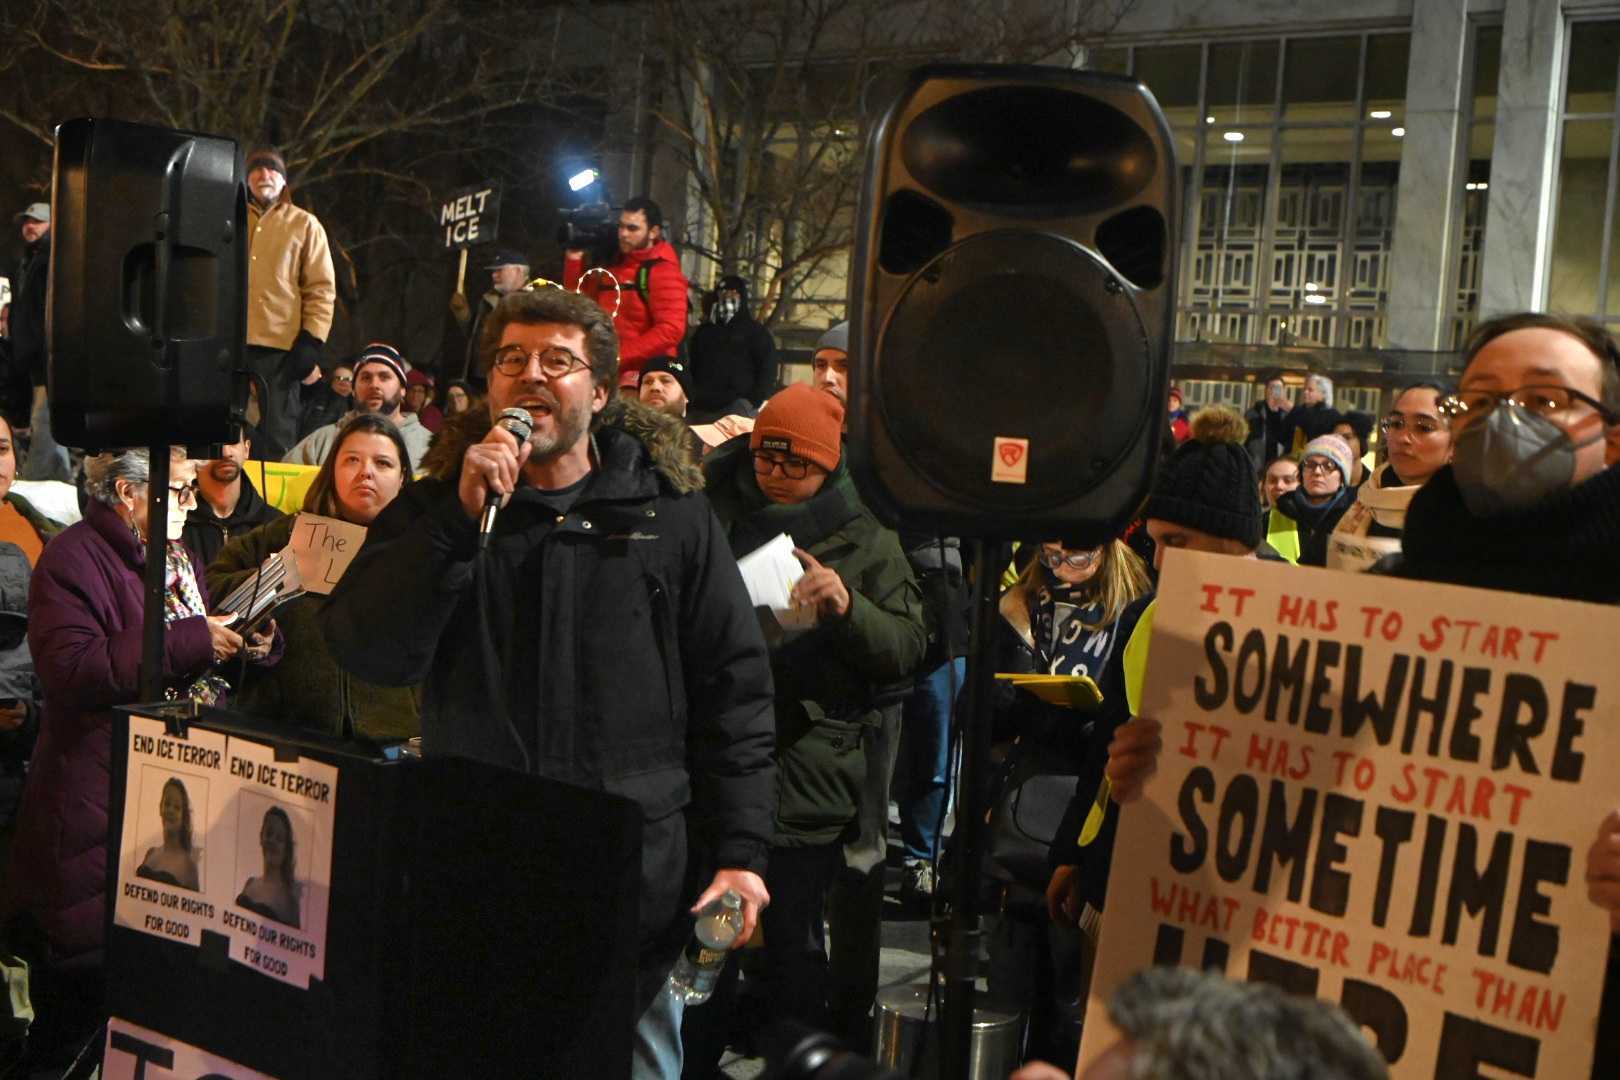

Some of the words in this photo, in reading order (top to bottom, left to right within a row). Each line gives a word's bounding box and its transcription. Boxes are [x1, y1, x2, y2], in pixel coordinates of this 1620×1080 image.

[441, 189, 492, 226] MELT
[446, 217, 480, 247] ICE
[304, 522, 347, 552] The
[1200, 584, 1256, 617] IT
[1277, 595, 1338, 632] HAS
[1361, 606, 1403, 642] TO
[1419, 615, 1560, 664] START
[1194, 621, 1597, 784] SOMEWHERE
[134, 734, 154, 754] END
[156, 737, 174, 759] ICE
[177, 743, 221, 770] TERROR
[230, 756, 254, 780] END
[257, 764, 277, 788] ICE
[281, 771, 330, 804] TERROR
[1179, 722, 1231, 762] IT
[1247, 733, 1313, 780] HAS
[1333, 752, 1376, 791] TO
[1391, 763, 1532, 826] START
[1170, 766, 1573, 976] SOMETIME
[124, 883, 159, 904] DEFEND
[160, 892, 179, 909] OUR
[181, 897, 216, 919] RIGHTS
[144, 914, 163, 931] FOR
[165, 920, 190, 938] GOOD
[223, 909, 258, 936] DEFEND
[258, 926, 279, 946] OUR
[280, 933, 316, 958] RIGHTS
[244, 946, 262, 967] FOR
[262, 955, 288, 977] GOOD
[1150, 877, 1240, 933] WHAT
[1252, 907, 1350, 967] BETTER
[1368, 941, 1448, 995] PLACE
[1472, 966, 1566, 1032] THAN
